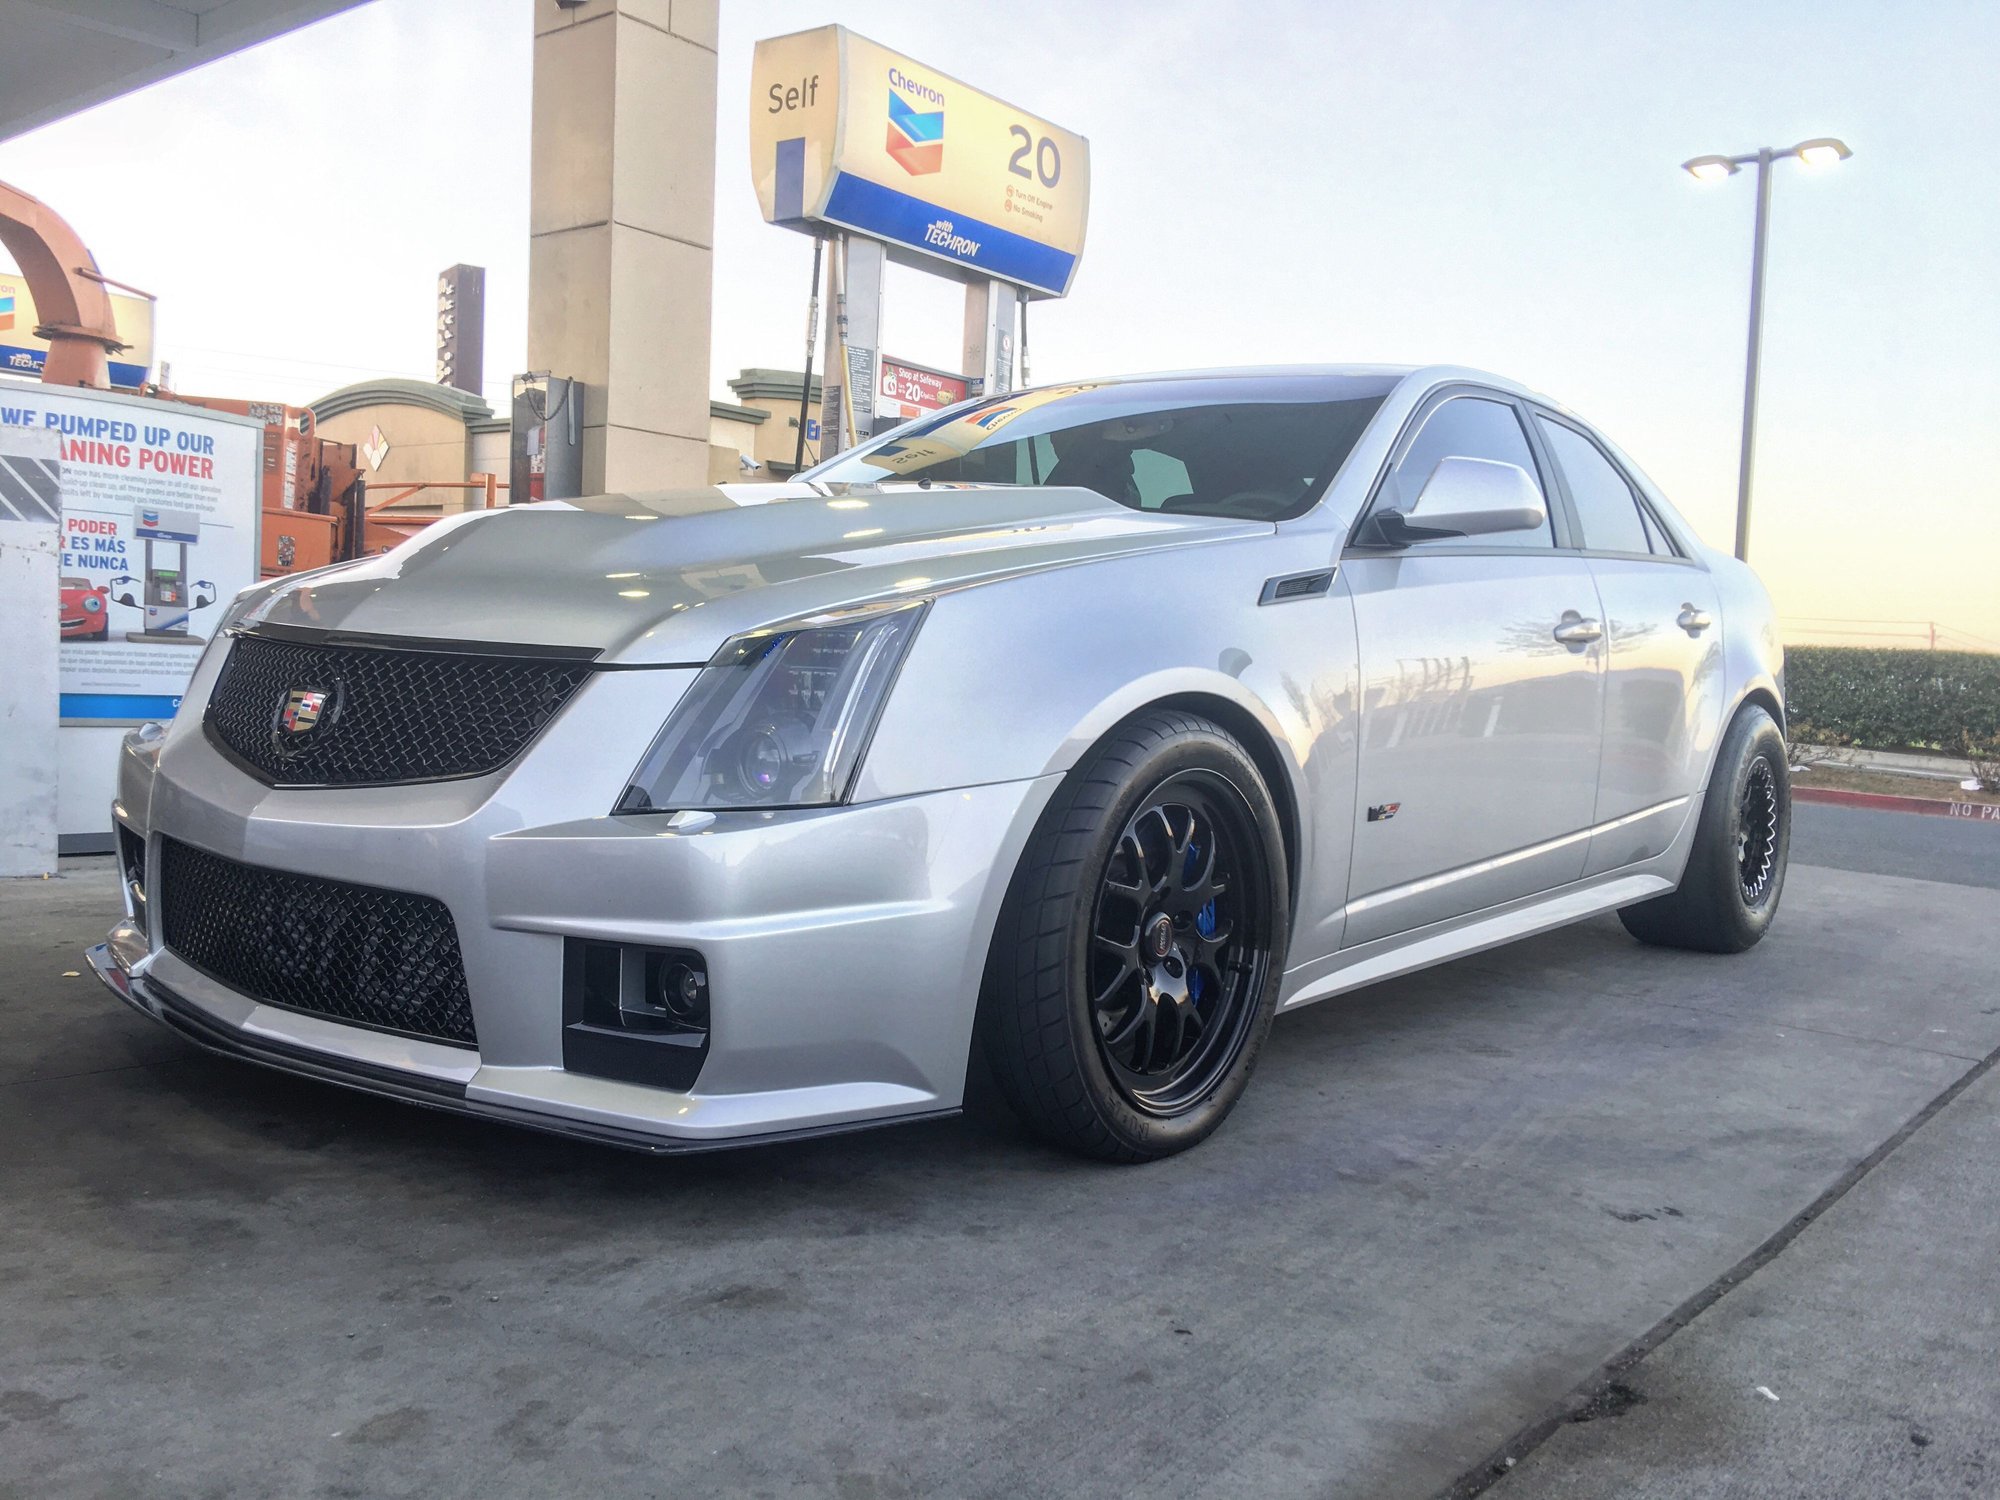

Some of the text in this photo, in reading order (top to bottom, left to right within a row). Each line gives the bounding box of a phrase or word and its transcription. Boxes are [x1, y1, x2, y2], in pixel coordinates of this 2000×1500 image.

[768, 75, 819, 114] Self
[888, 67, 945, 107] Chevron
[1008, 124, 1061, 189] 20
[1015, 188, 1053, 210] Turn Off Engine
[1013, 203, 1044, 223] No Smoking
[935, 219, 953, 233] with
[924, 223, 981, 257] TECHRON
[898, 367, 943, 390] Shop at Safeway
[905, 382, 921, 402] 20
[45, 412, 138, 443] PUMPED
[144, 426, 171, 448] UP
[177, 431, 215, 455] OUR
[139, 448, 214, 480] POWER
[68, 518, 118, 535] PODER
[71, 536, 90, 550] ES
[95, 536, 126, 553] MÁS
[78, 554, 129, 571] NUNCA
[1950, 803, 2000, 820] NO PA
